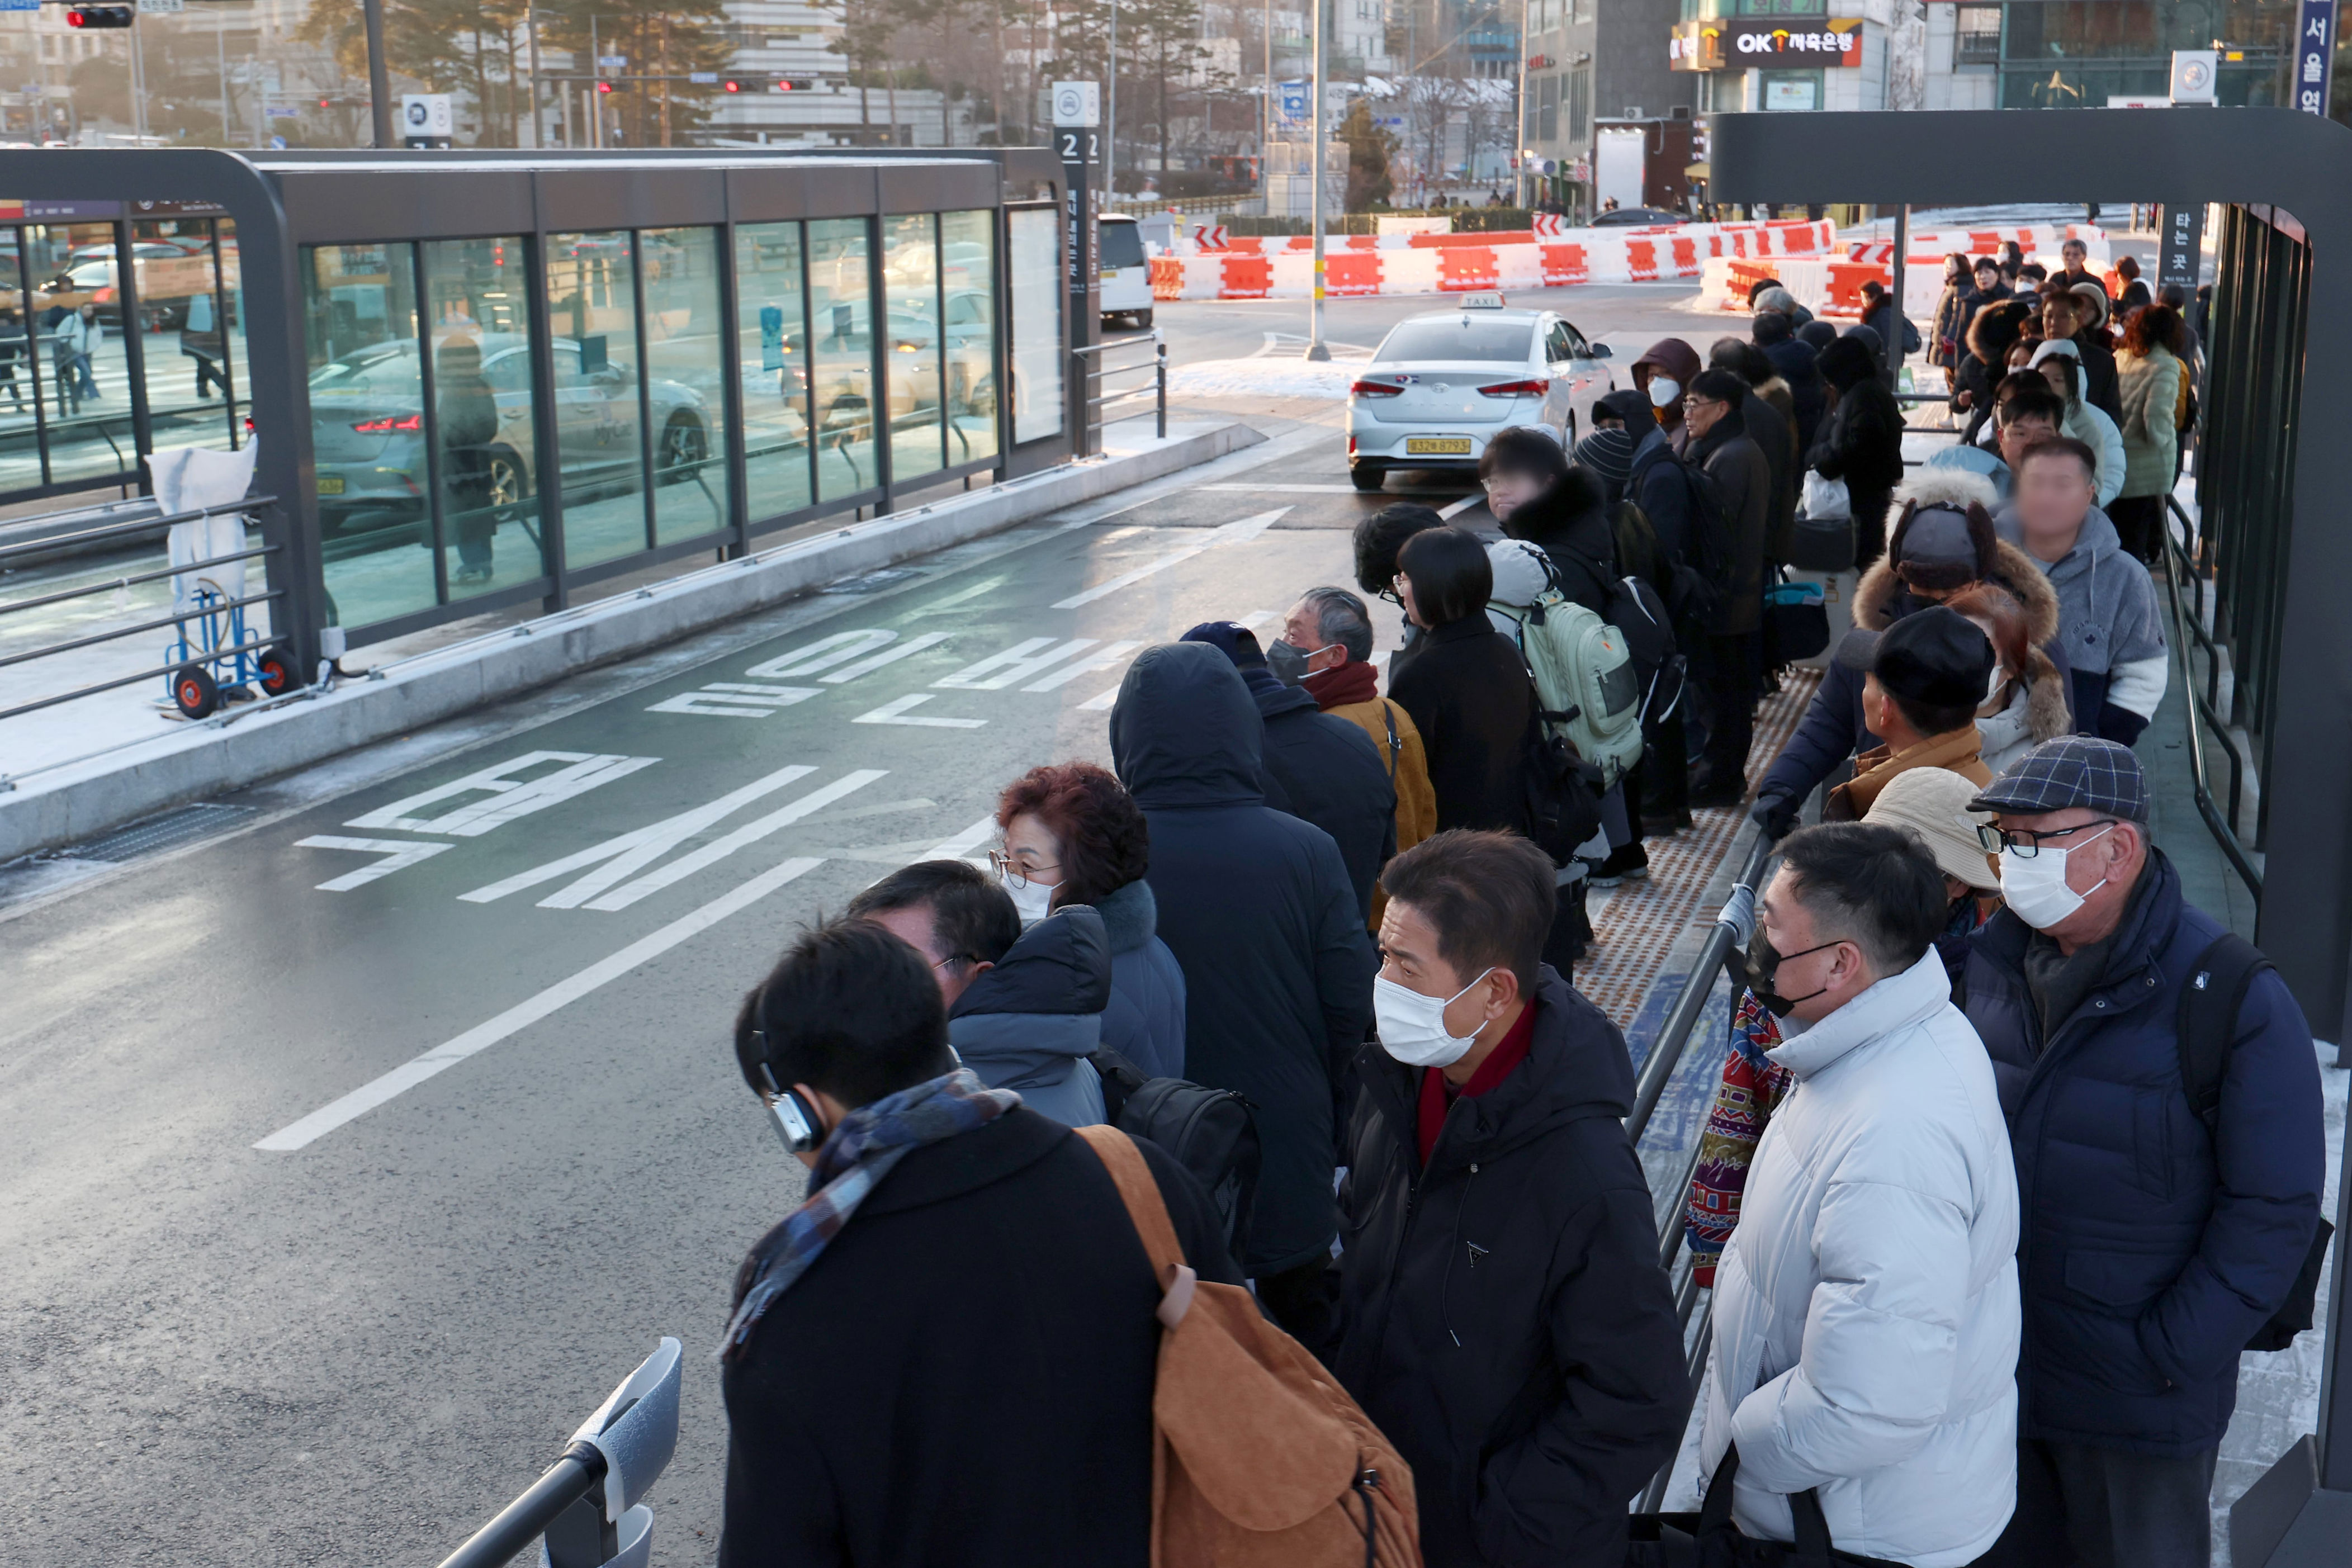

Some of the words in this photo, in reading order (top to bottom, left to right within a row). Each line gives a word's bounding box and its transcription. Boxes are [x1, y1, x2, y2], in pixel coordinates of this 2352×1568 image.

[1736, 34, 1772, 53] OK
[1789, 32, 1853, 52] 저축은행
[1063, 134, 1078, 157] 2
[1090, 134, 1098, 157] 2
[2174, 212, 2191, 245] 타는
[2172, 254, 2187, 269] 곳
